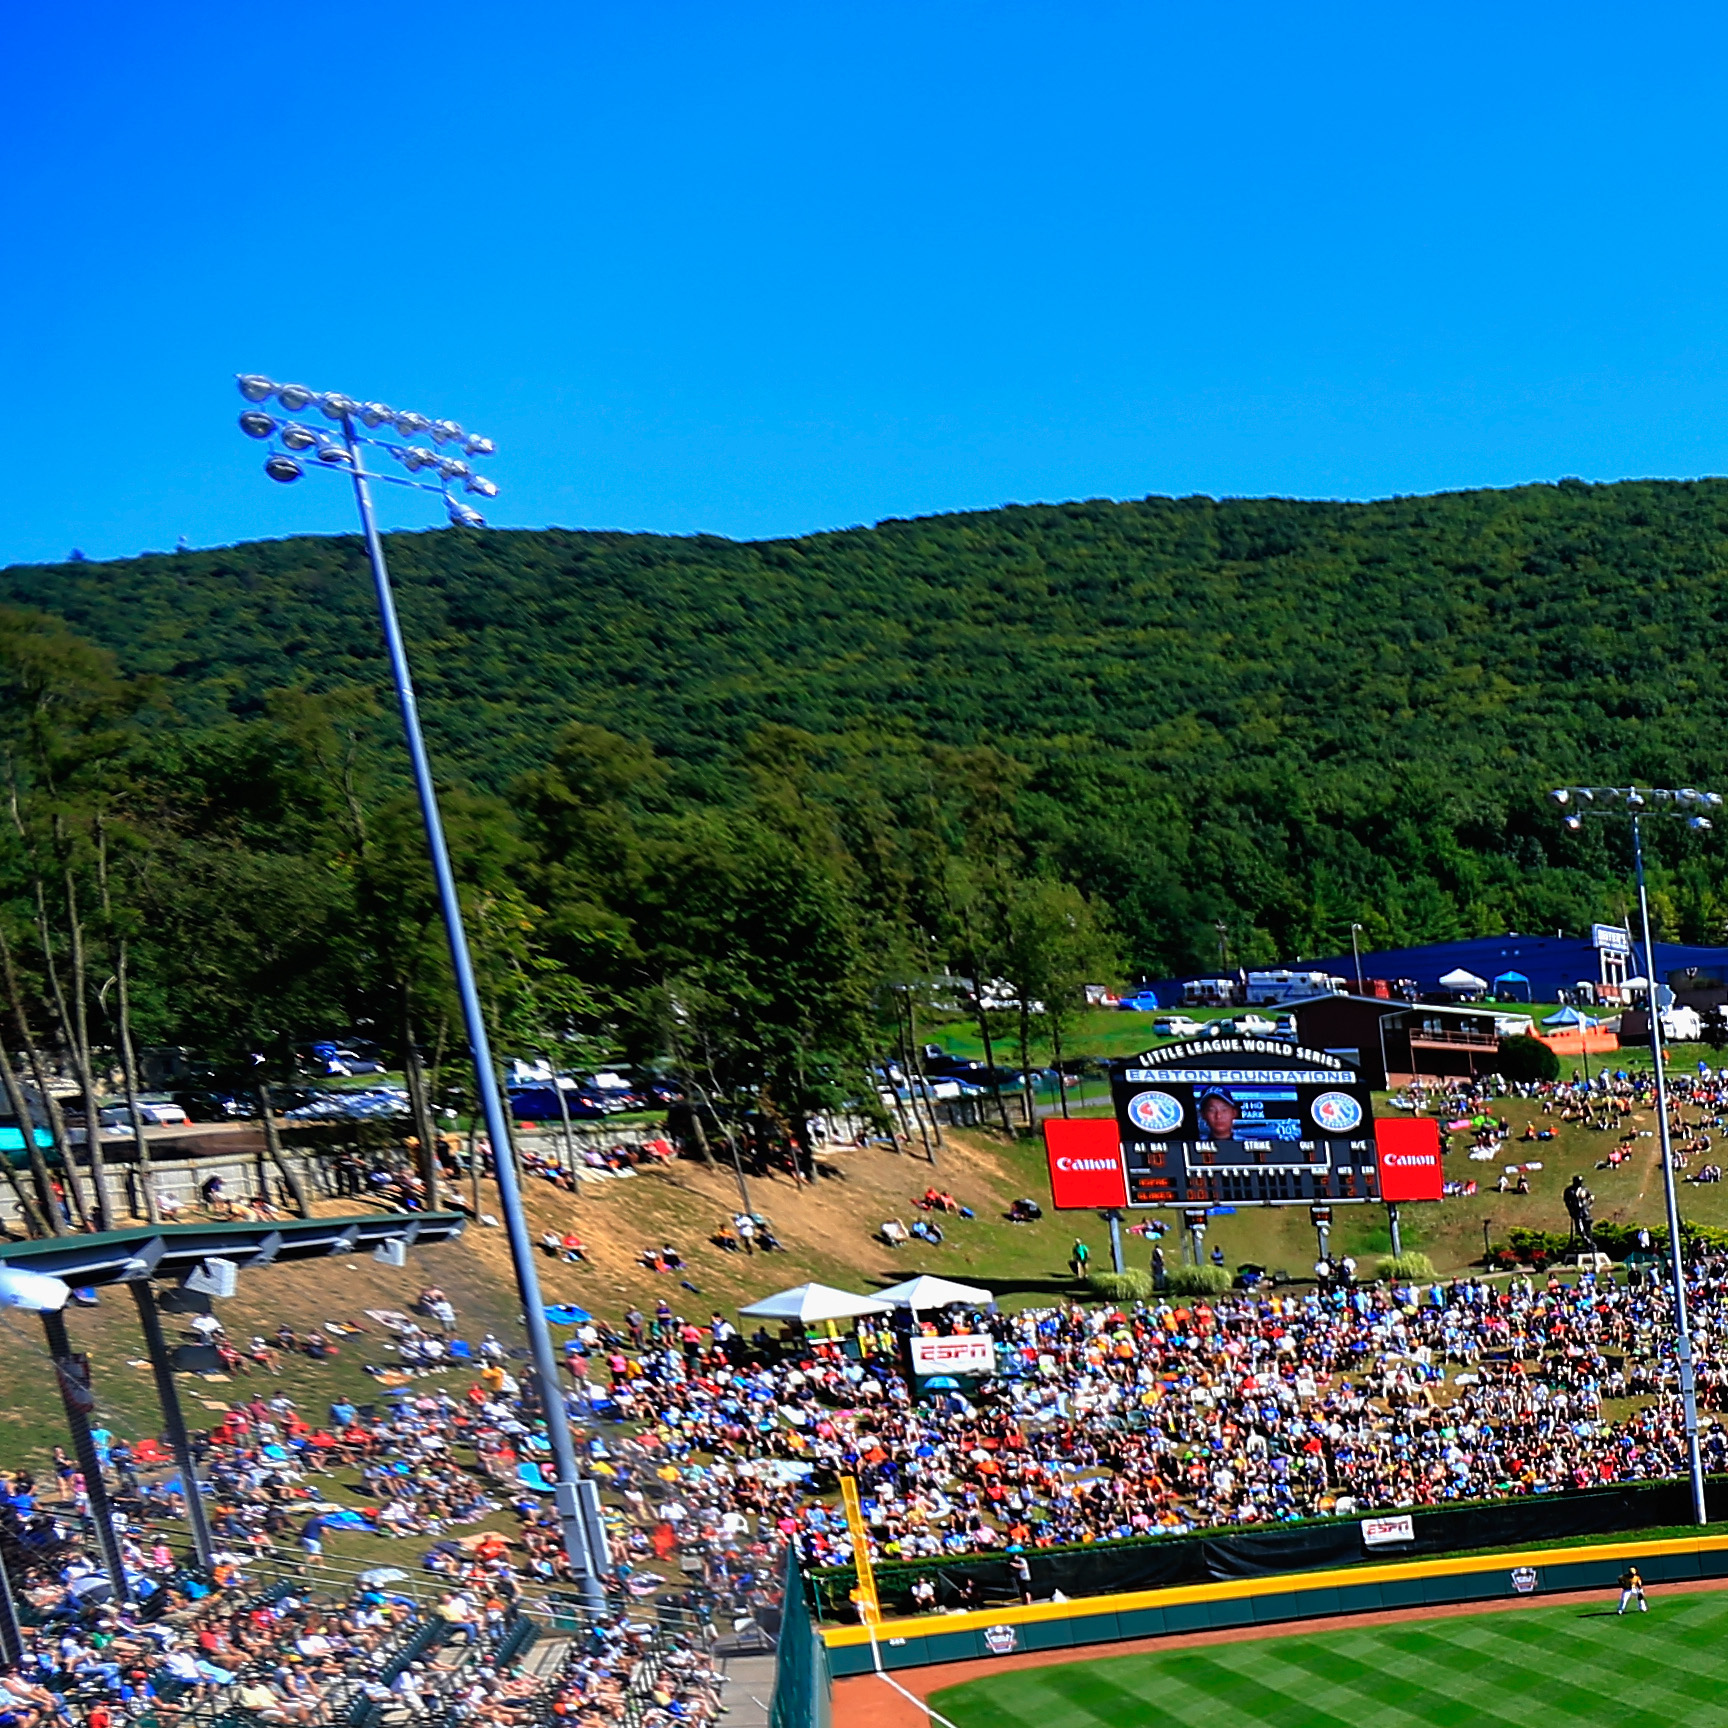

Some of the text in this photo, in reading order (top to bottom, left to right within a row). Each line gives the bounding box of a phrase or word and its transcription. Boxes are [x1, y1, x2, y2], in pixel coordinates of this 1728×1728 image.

[1140, 1039, 1342, 1069] LITTLE LEAGUE WORLD SERIES
[1129, 1070, 1352, 1081] EASTON FOUNDATIONS
[1056, 1157, 1118, 1171] Canon
[1383, 1153, 1436, 1166] Canon
[920, 1343, 986, 1361] ESPN
[1366, 1520, 1409, 1536] ESPN
